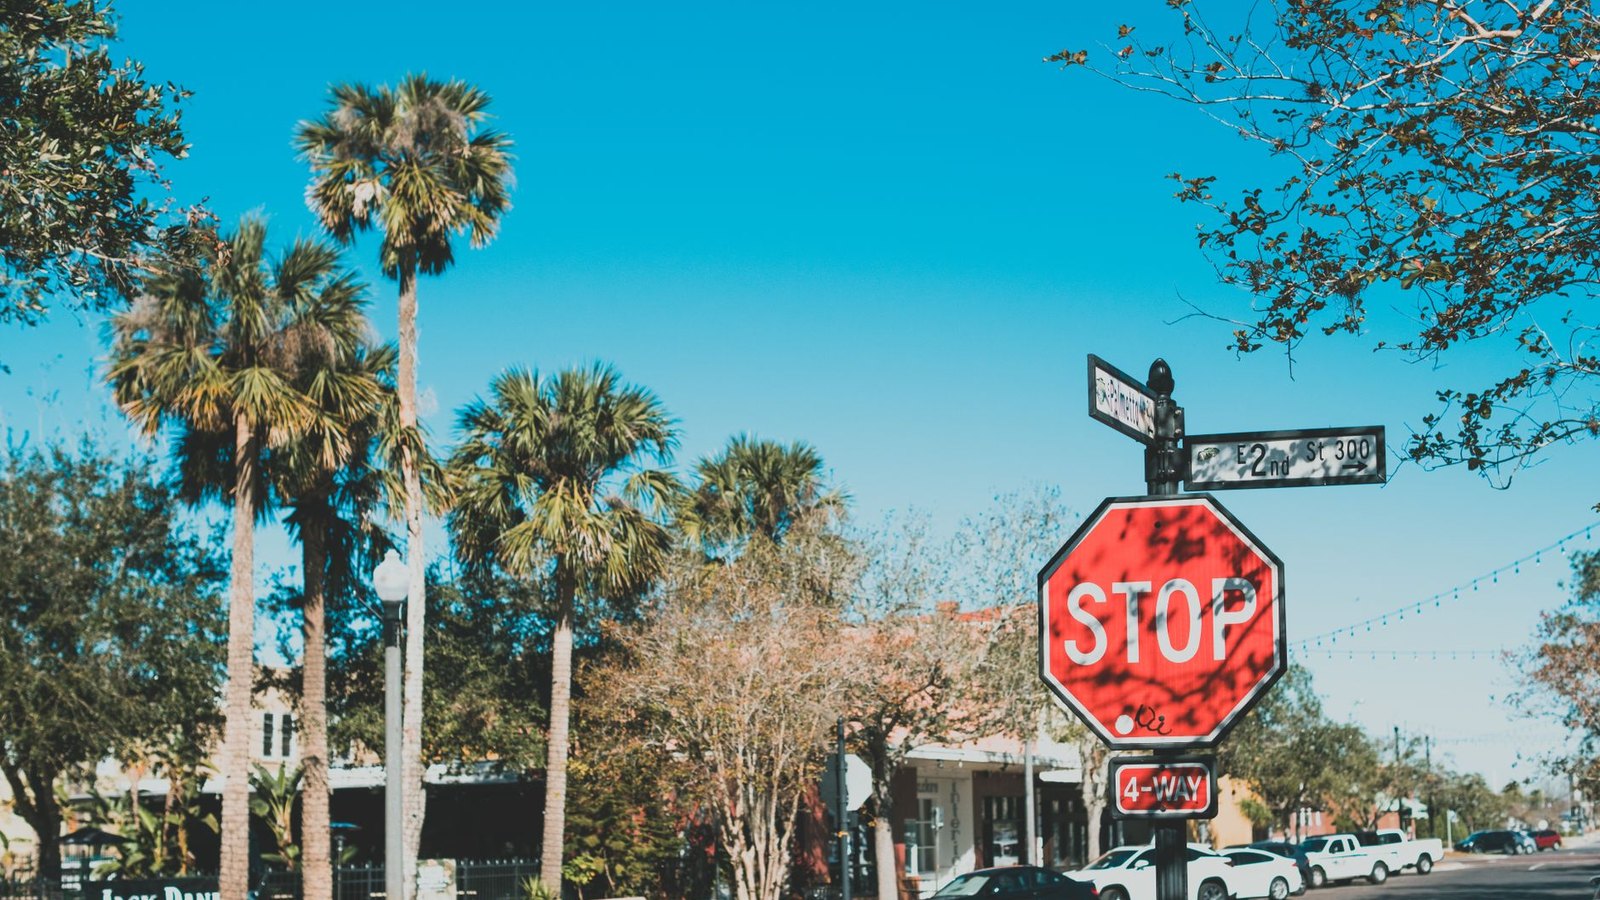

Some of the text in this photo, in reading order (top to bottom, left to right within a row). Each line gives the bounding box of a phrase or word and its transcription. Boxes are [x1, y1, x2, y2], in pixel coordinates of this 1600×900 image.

[1237, 439, 1369, 476] E 2nd St 300
[1064, 578, 1257, 666] STOP
[1123, 776, 1202, 802] 4-WAY
